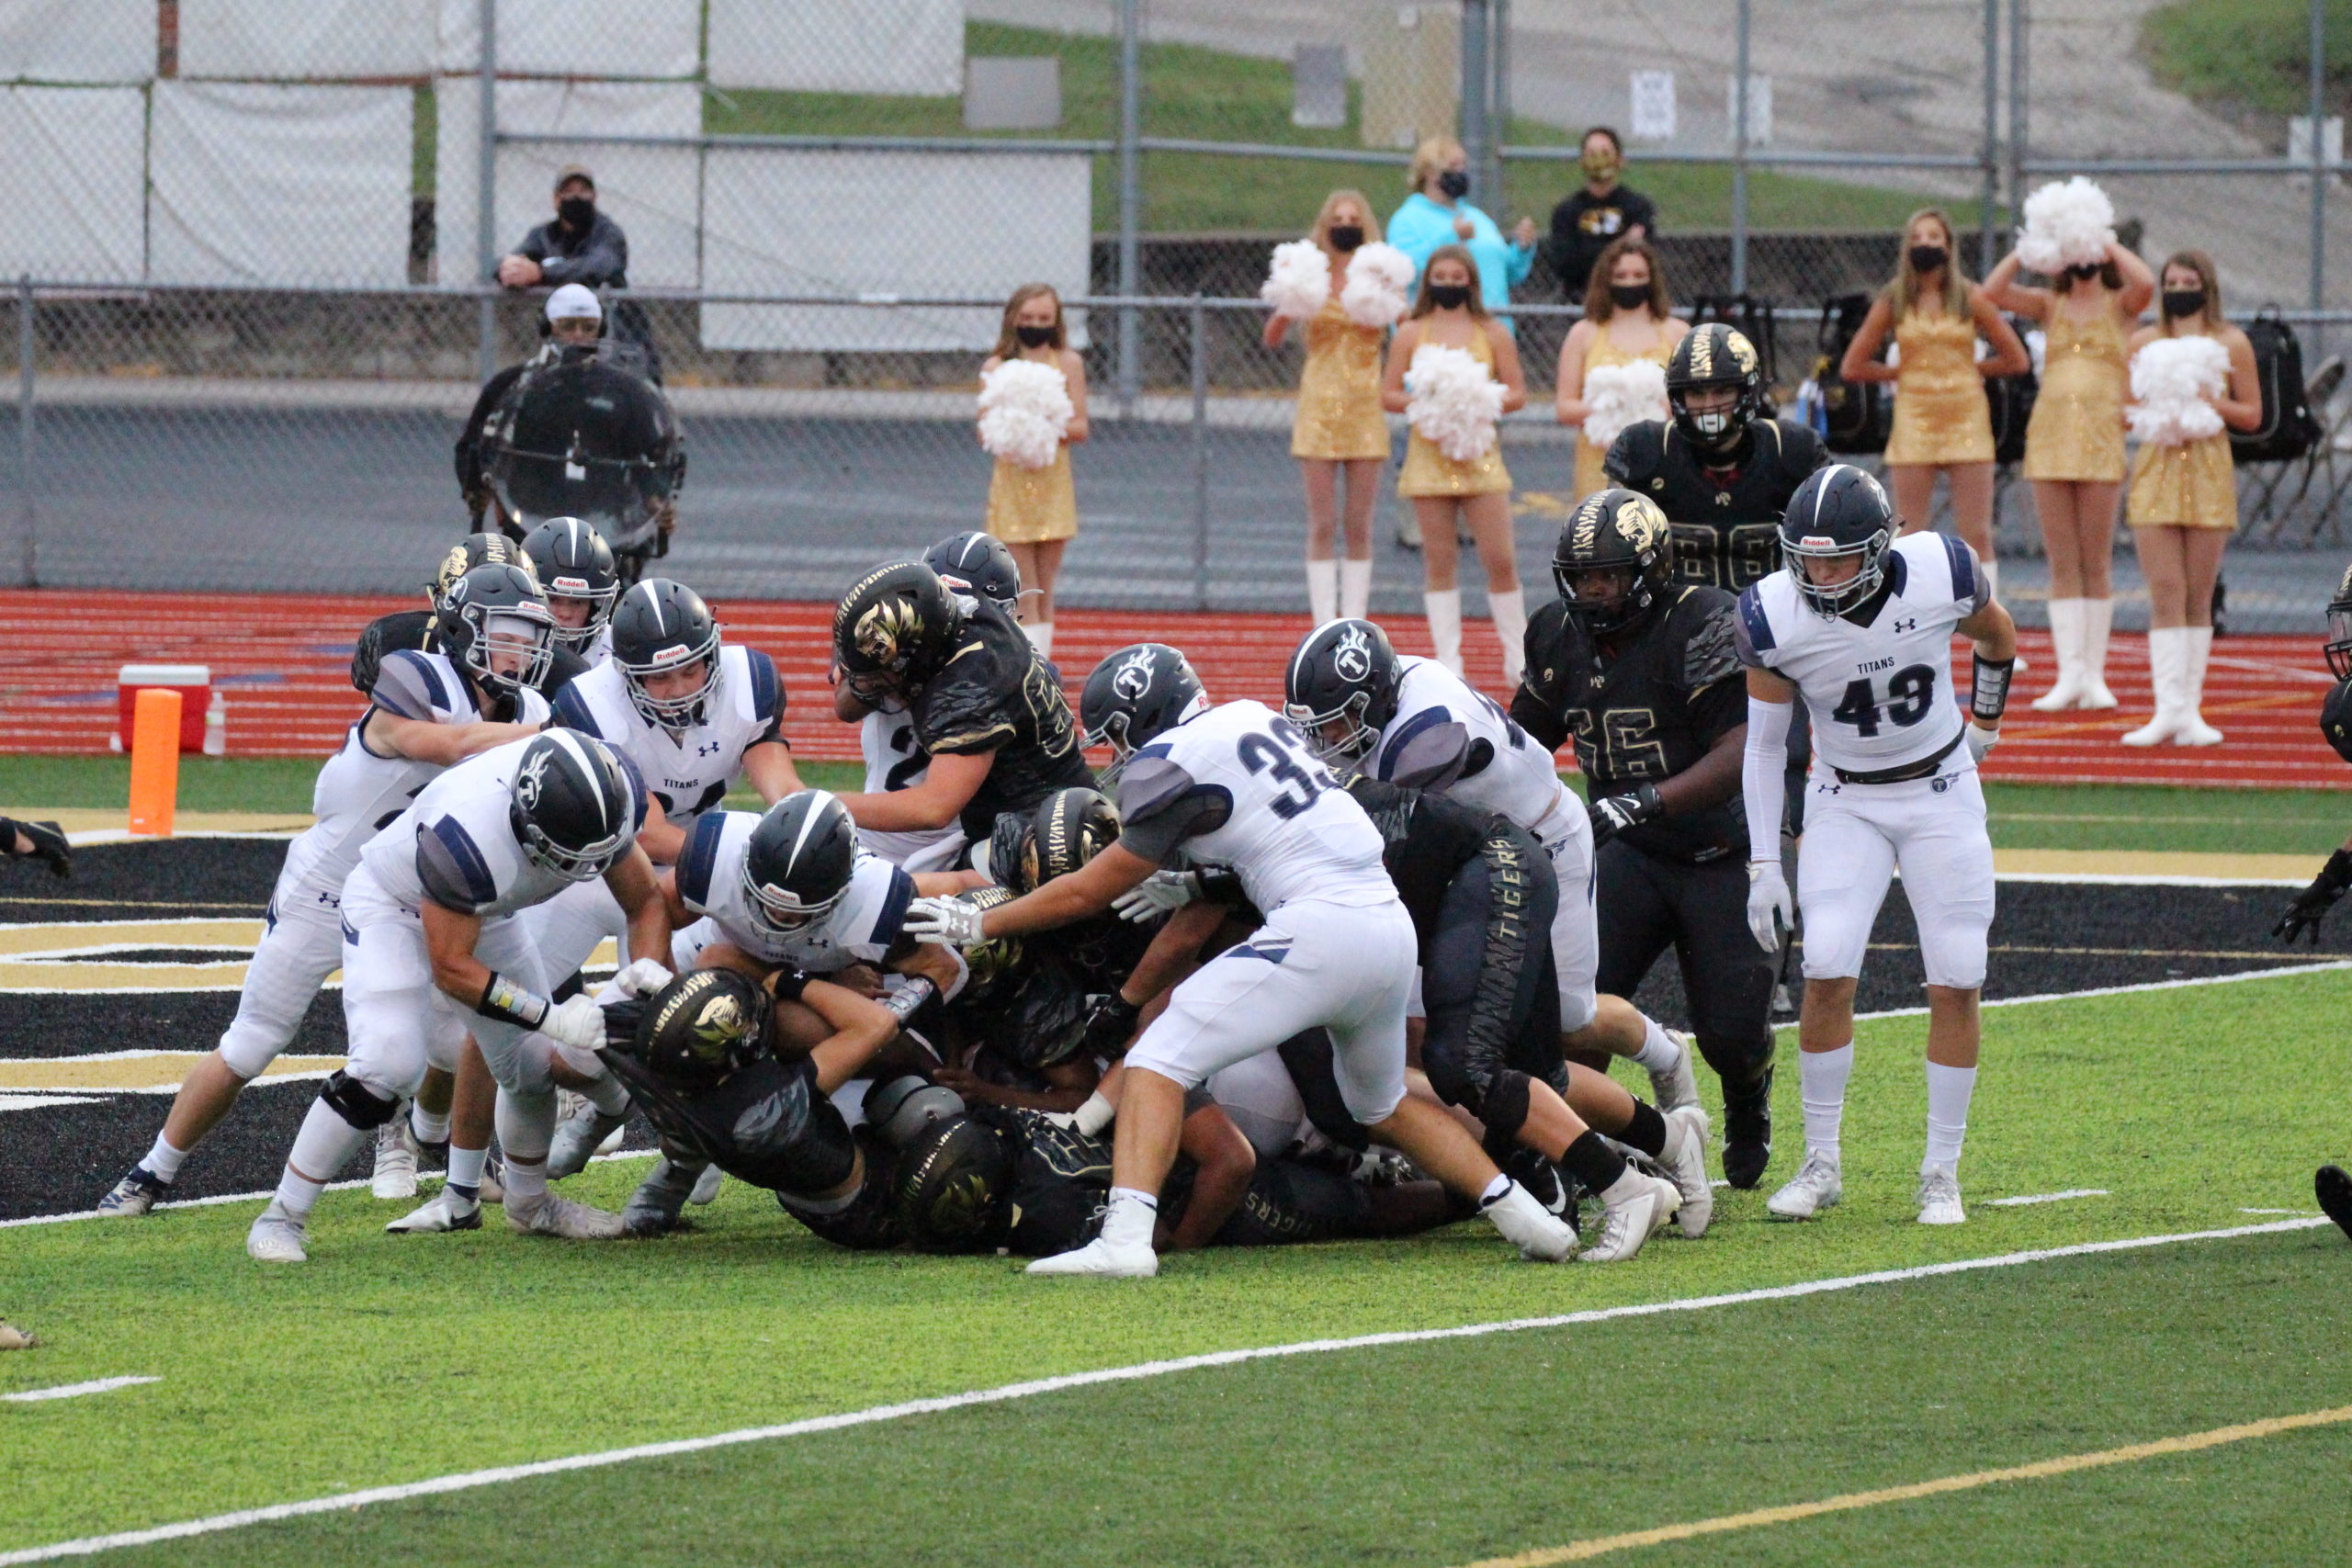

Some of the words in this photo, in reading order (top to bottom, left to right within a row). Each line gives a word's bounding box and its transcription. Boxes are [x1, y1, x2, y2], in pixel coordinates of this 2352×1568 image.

[557, 579, 585, 588] Riddell
[656, 647, 685, 660] Riddell
[1857, 656, 1895, 674] TITANS
[663, 778, 699, 789] TITANS
[1487, 839, 1521, 938] TIGERS
